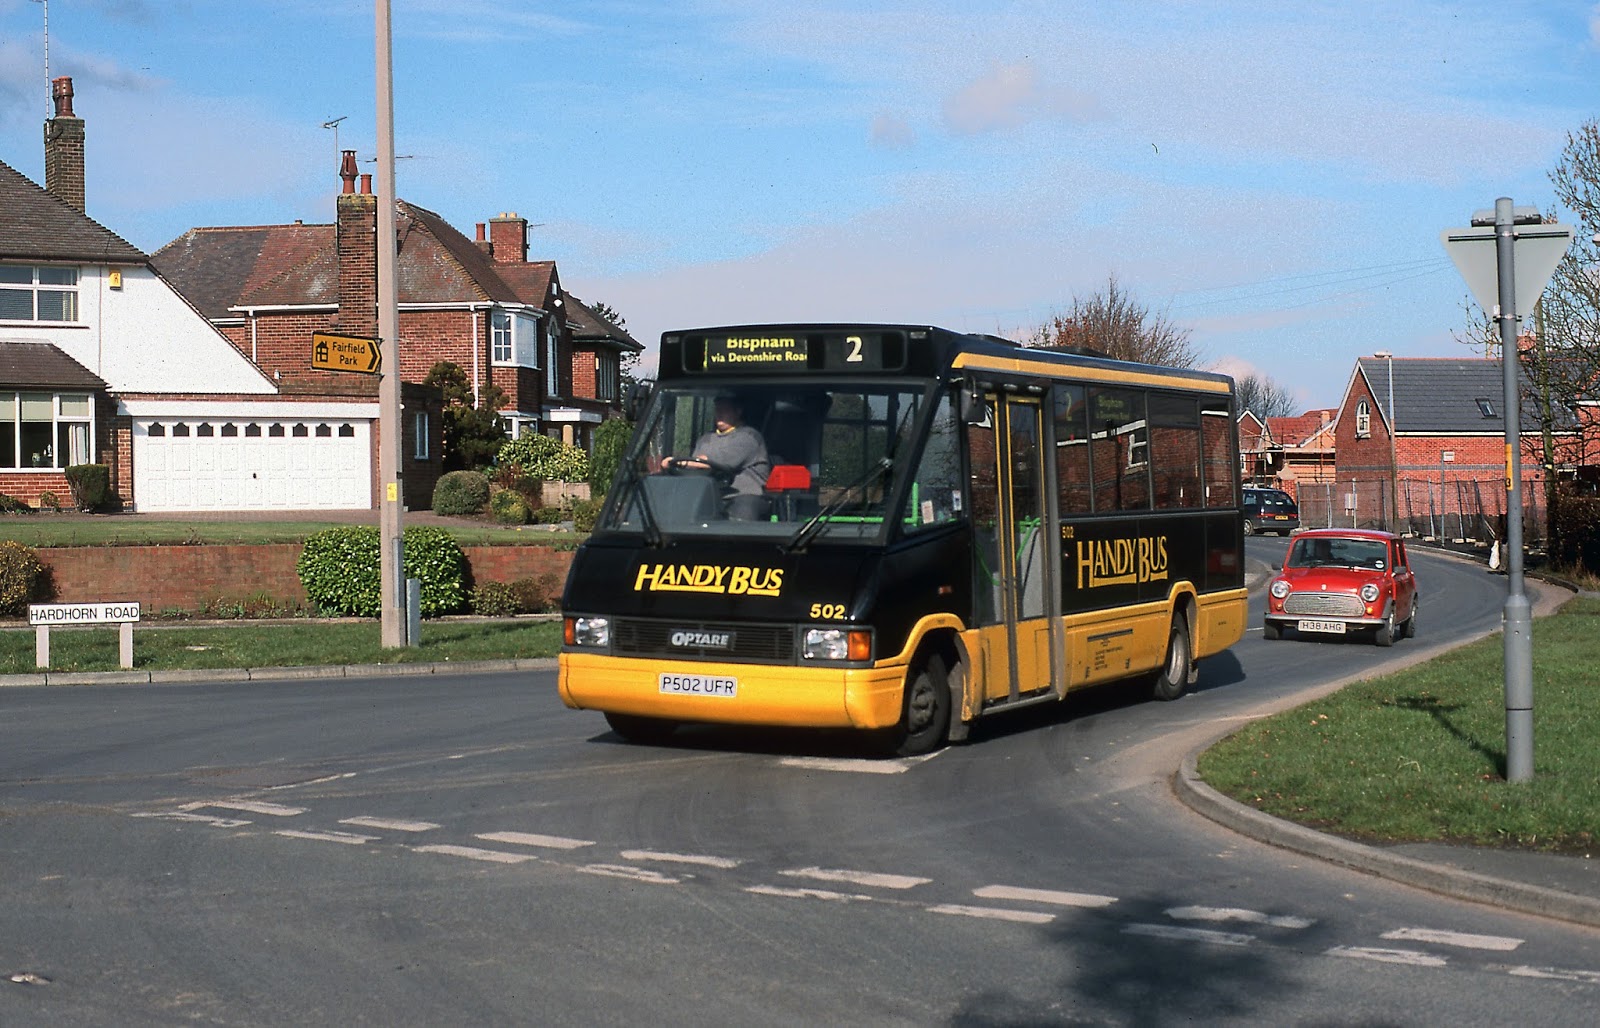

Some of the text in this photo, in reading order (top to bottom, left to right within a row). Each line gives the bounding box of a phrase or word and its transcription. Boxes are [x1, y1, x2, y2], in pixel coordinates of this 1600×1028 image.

[332, 341, 366, 354] Fairfield
[726, 337, 796, 352] Bispham
[846, 336, 863, 362] 2
[339, 355, 358, 366] Park
[711, 351, 808, 363] via Devonshire Roa
[1062, 526, 1074, 538] 502
[30, 606, 139, 621] HARDHORN ROAD
[810, 603, 846, 620] 502
[1323, 623, 1342, 631] AHG
[671, 632, 729, 646] OPTARE
[662, 676, 734, 694] P502 UFR
